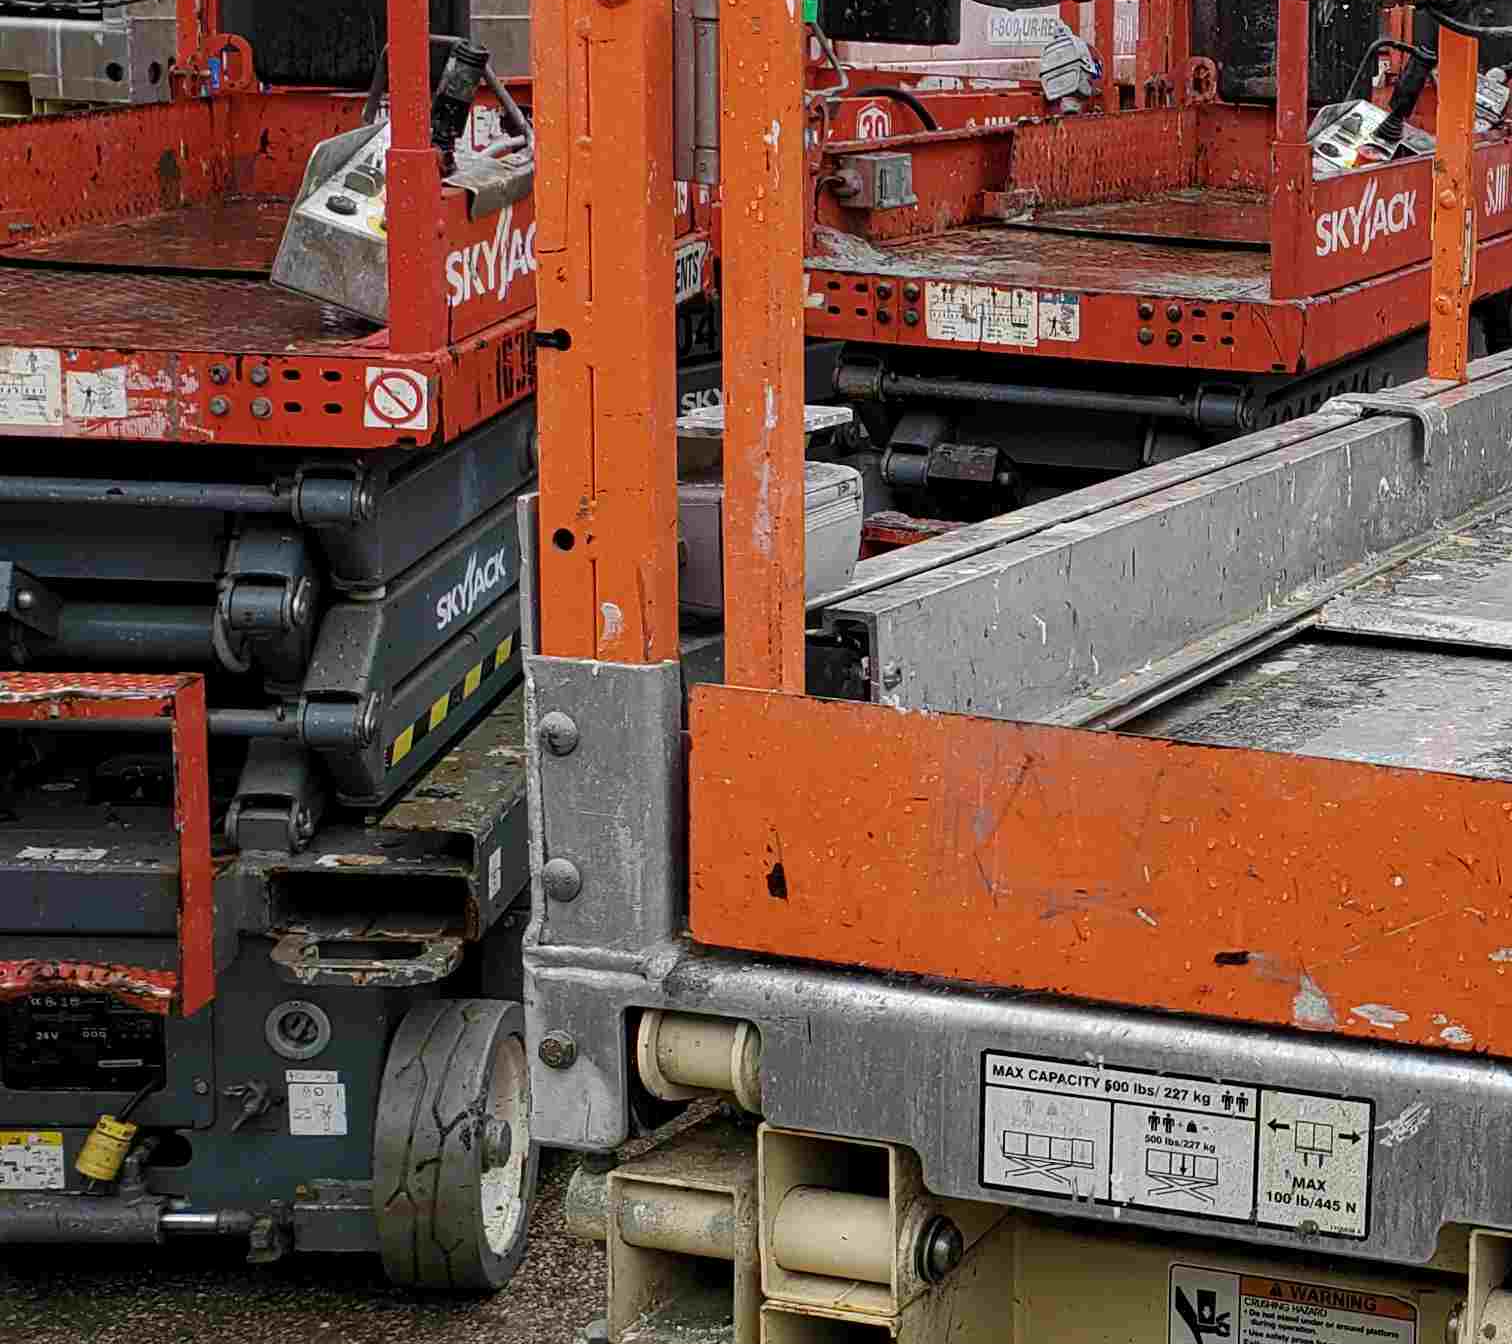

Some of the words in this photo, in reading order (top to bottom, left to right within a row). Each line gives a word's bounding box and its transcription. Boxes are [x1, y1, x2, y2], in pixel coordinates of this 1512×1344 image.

[1316, 175, 1417, 257] SKYJACK
[446, 205, 537, 308] SKYJAC
[437, 547, 507, 631] SKYJACK
[992, 1063, 1024, 1080] MAX
[1027, 1069, 1101, 1090] CAPACITY
[1104, 1078, 1130, 1094] 500
[1163, 1086, 1189, 1101] 227
[1193, 1089, 1212, 1107] kg
[1144, 1133, 1163, 1145] 500
[1203, 1141, 1217, 1154] kg
[1292, 1176, 1328, 1193] MAX
[1266, 1190, 1292, 1205] 100
[1295, 1194, 1341, 1212] lb/445
[1345, 1201, 1357, 1214] N
[1289, 1284, 1378, 1312] WARNING
[1297, 1315, 1324, 1326] under
[1248, 1328, 1265, 1337] Use
[1265, 1332, 1290, 1344] safety
